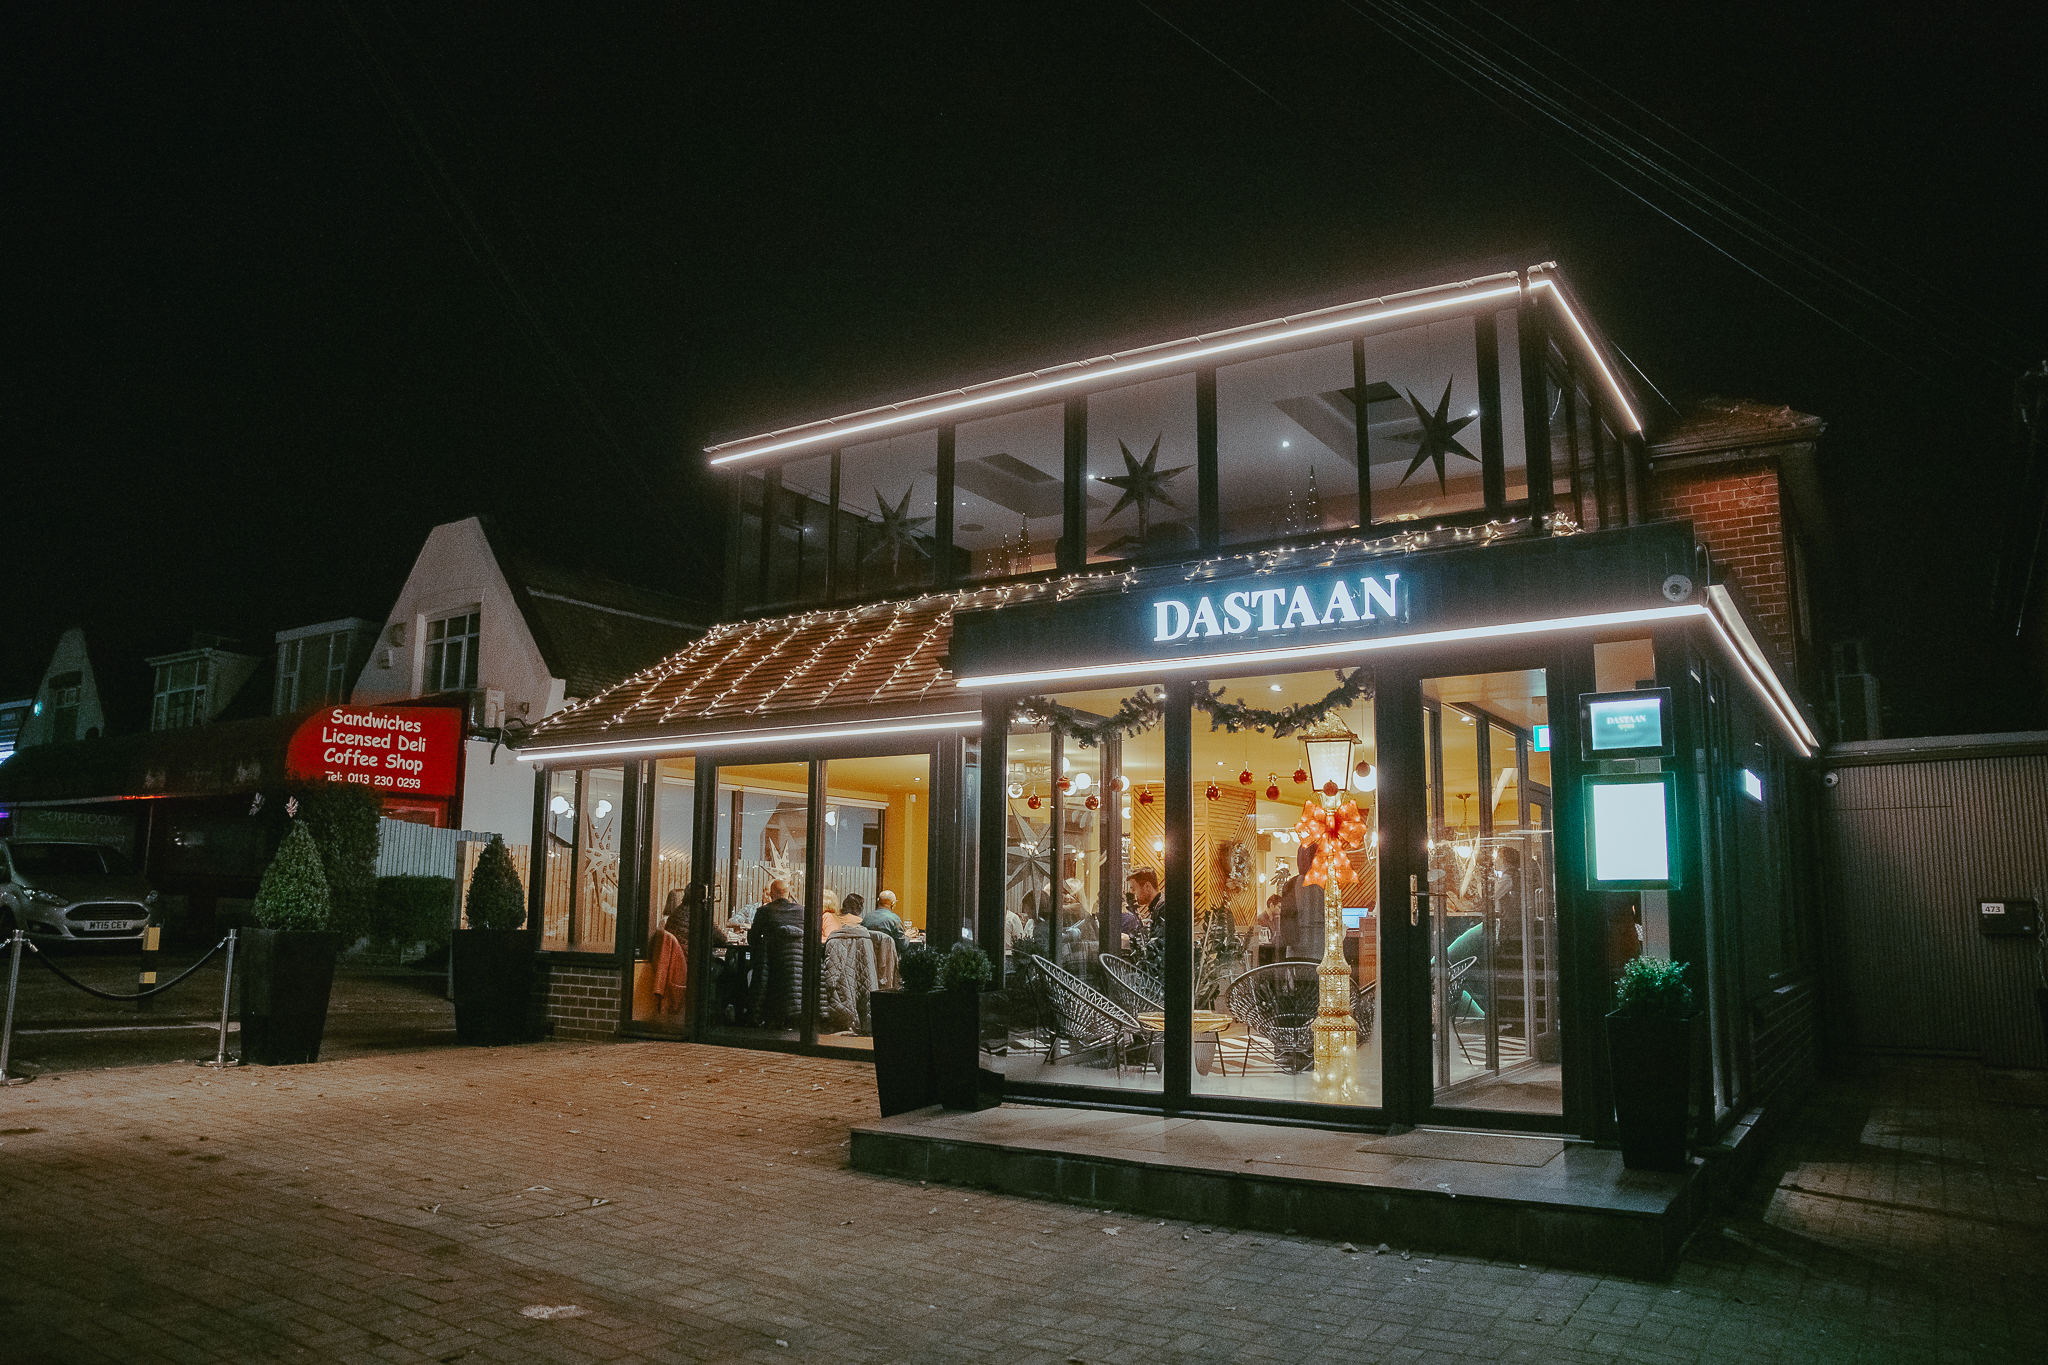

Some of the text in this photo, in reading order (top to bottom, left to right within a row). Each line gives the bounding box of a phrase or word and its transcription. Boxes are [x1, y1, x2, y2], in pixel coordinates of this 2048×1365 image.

[1153, 573, 1399, 642] DASTAAN
[331, 709, 421, 732] Sandwiches
[1607, 715, 1646, 724] DASTAAN
[322, 727, 426, 752] Licensed Deli
[324, 748, 423, 775] Coffee Shop
[325, 771, 421, 789] Tel: 0113 230 0293
